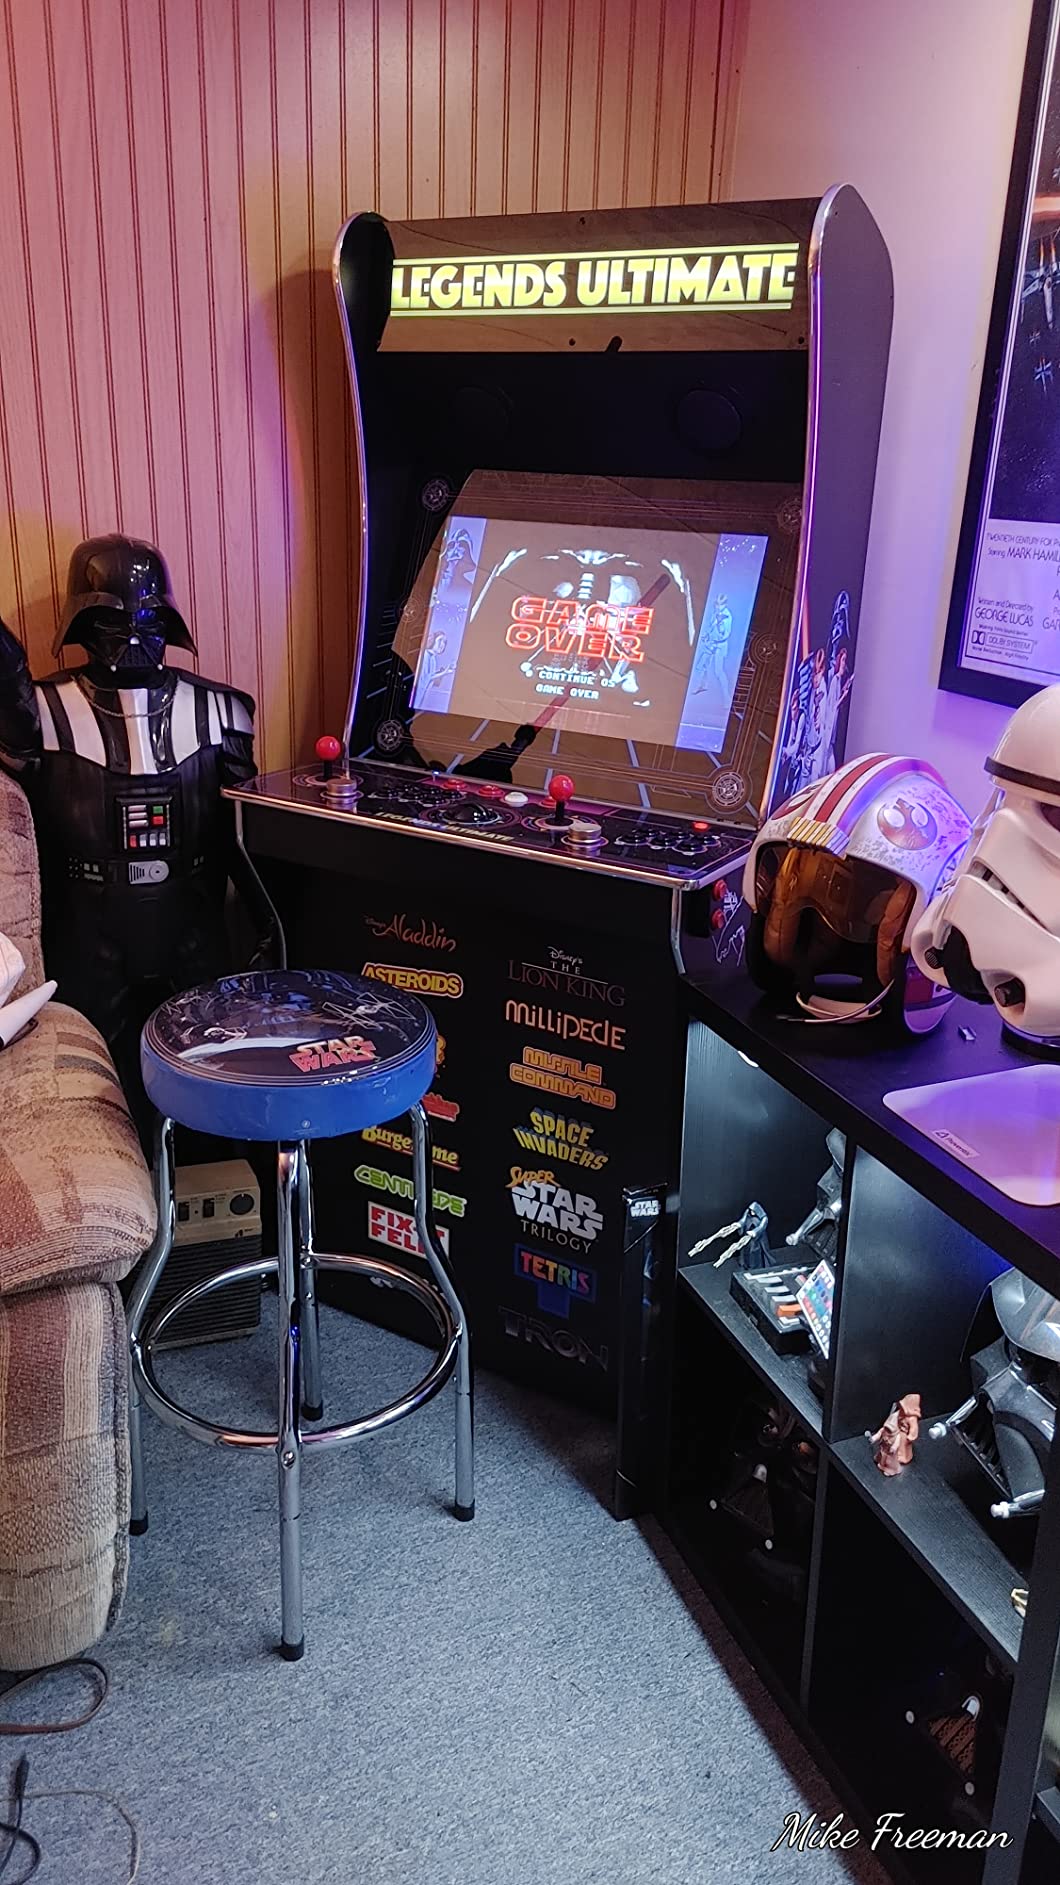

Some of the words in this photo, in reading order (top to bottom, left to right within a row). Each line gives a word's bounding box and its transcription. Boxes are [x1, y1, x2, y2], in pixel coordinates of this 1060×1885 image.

[391, 261, 567, 310] LEGENDS
[576, 251, 799, 306] ULTIMATE
[1007, 546, 1032, 560] MARK
[1033, 549, 1060, 563] HAMIL
[511, 596, 654, 635] GAME
[975, 607, 1008, 623] GEORGE
[1009, 612, 1034, 627] LUCAS
[505, 623, 645, 663] OVER
[1006, 639, 1031, 650] SYSTEM
[535, 684, 564, 696] GAME
[570, 687, 599, 700] OVER
[538, 670, 595, 686] CONTINUE
[372, 914, 457, 952] Aladdin
[363, 963, 463, 998] ASTEROIDS
[507, 960, 560, 991] LION
[566, 975, 626, 1007] KING
[550, 960, 581, 975] THE
[289, 1048, 378, 1072] WARS
[297, 1035, 377, 1056] STAR
[510, 1062, 617, 1110] COMMAND
[361, 1125, 459, 1165] Burgeme
[529, 1108, 594, 1148] SPACE
[513, 1126, 609, 1170] INVADERS
[354, 1165, 467, 1217] CENTIDE
[505, 1166, 561, 1188] SUPER
[511, 1193, 603, 1241] WARS
[512, 1180, 604, 1223] STAR
[630, 1206, 660, 1217] WARS
[634, 1199, 659, 1209] STAR
[520, 1219, 592, 1254] TRILOGY
[520, 1250, 591, 1294] TETRIS
[498, 1304, 609, 1372] TRON
